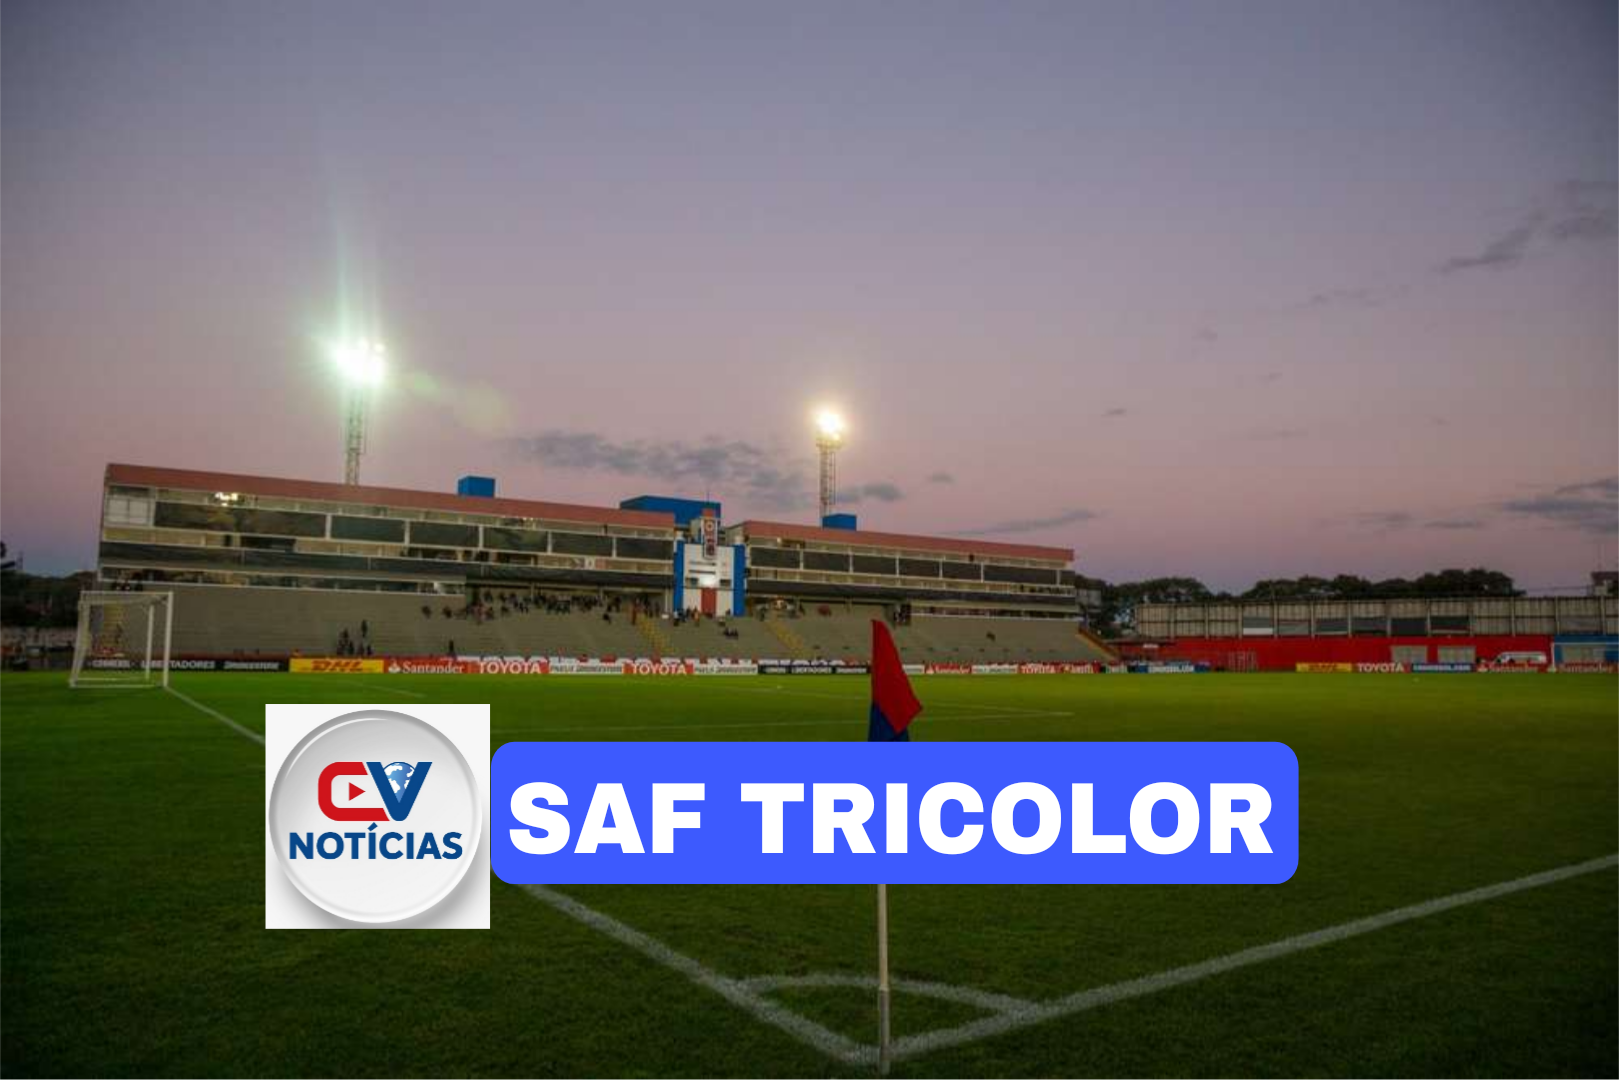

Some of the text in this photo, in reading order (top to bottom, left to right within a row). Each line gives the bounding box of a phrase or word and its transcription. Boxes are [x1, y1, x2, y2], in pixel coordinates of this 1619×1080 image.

[311, 660, 364, 672] DHL
[403, 660, 465, 674] Santander
[479, 661, 542, 674] TOYOTA
[631, 663, 687, 674] TOYOTA
[1357, 662, 1404, 673] TOYOTA
